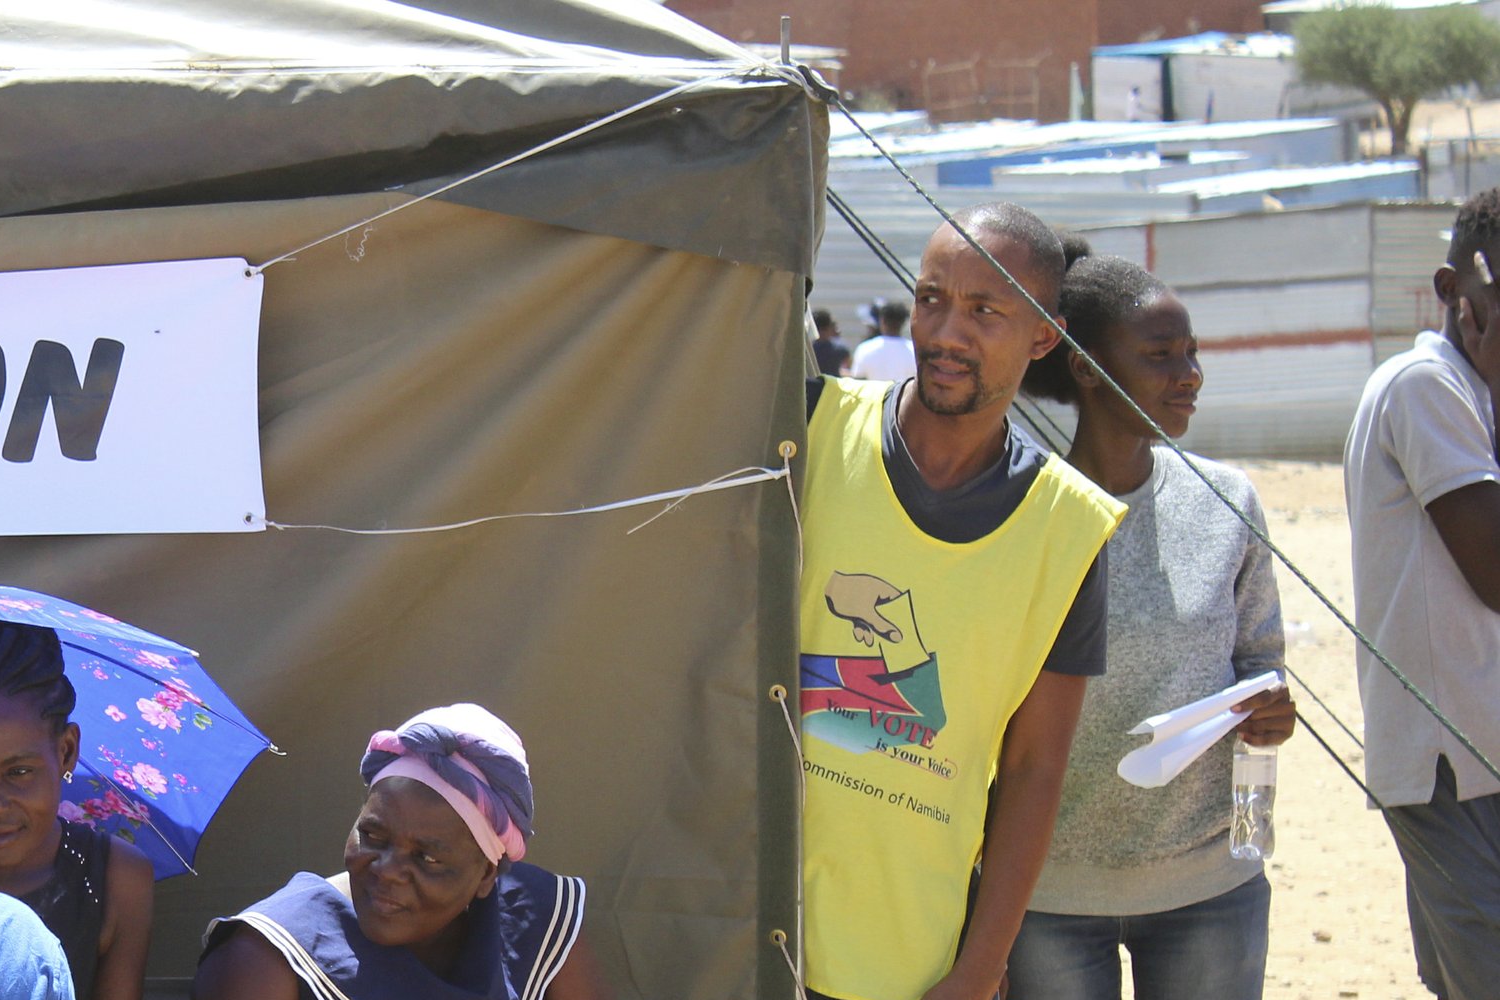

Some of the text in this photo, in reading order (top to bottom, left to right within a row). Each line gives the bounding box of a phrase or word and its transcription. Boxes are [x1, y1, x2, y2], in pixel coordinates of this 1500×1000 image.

[826, 698, 939, 750] Your VOTE
[875, 738, 952, 779] is your Voice
[802, 753, 951, 824] ommission of Namibia
